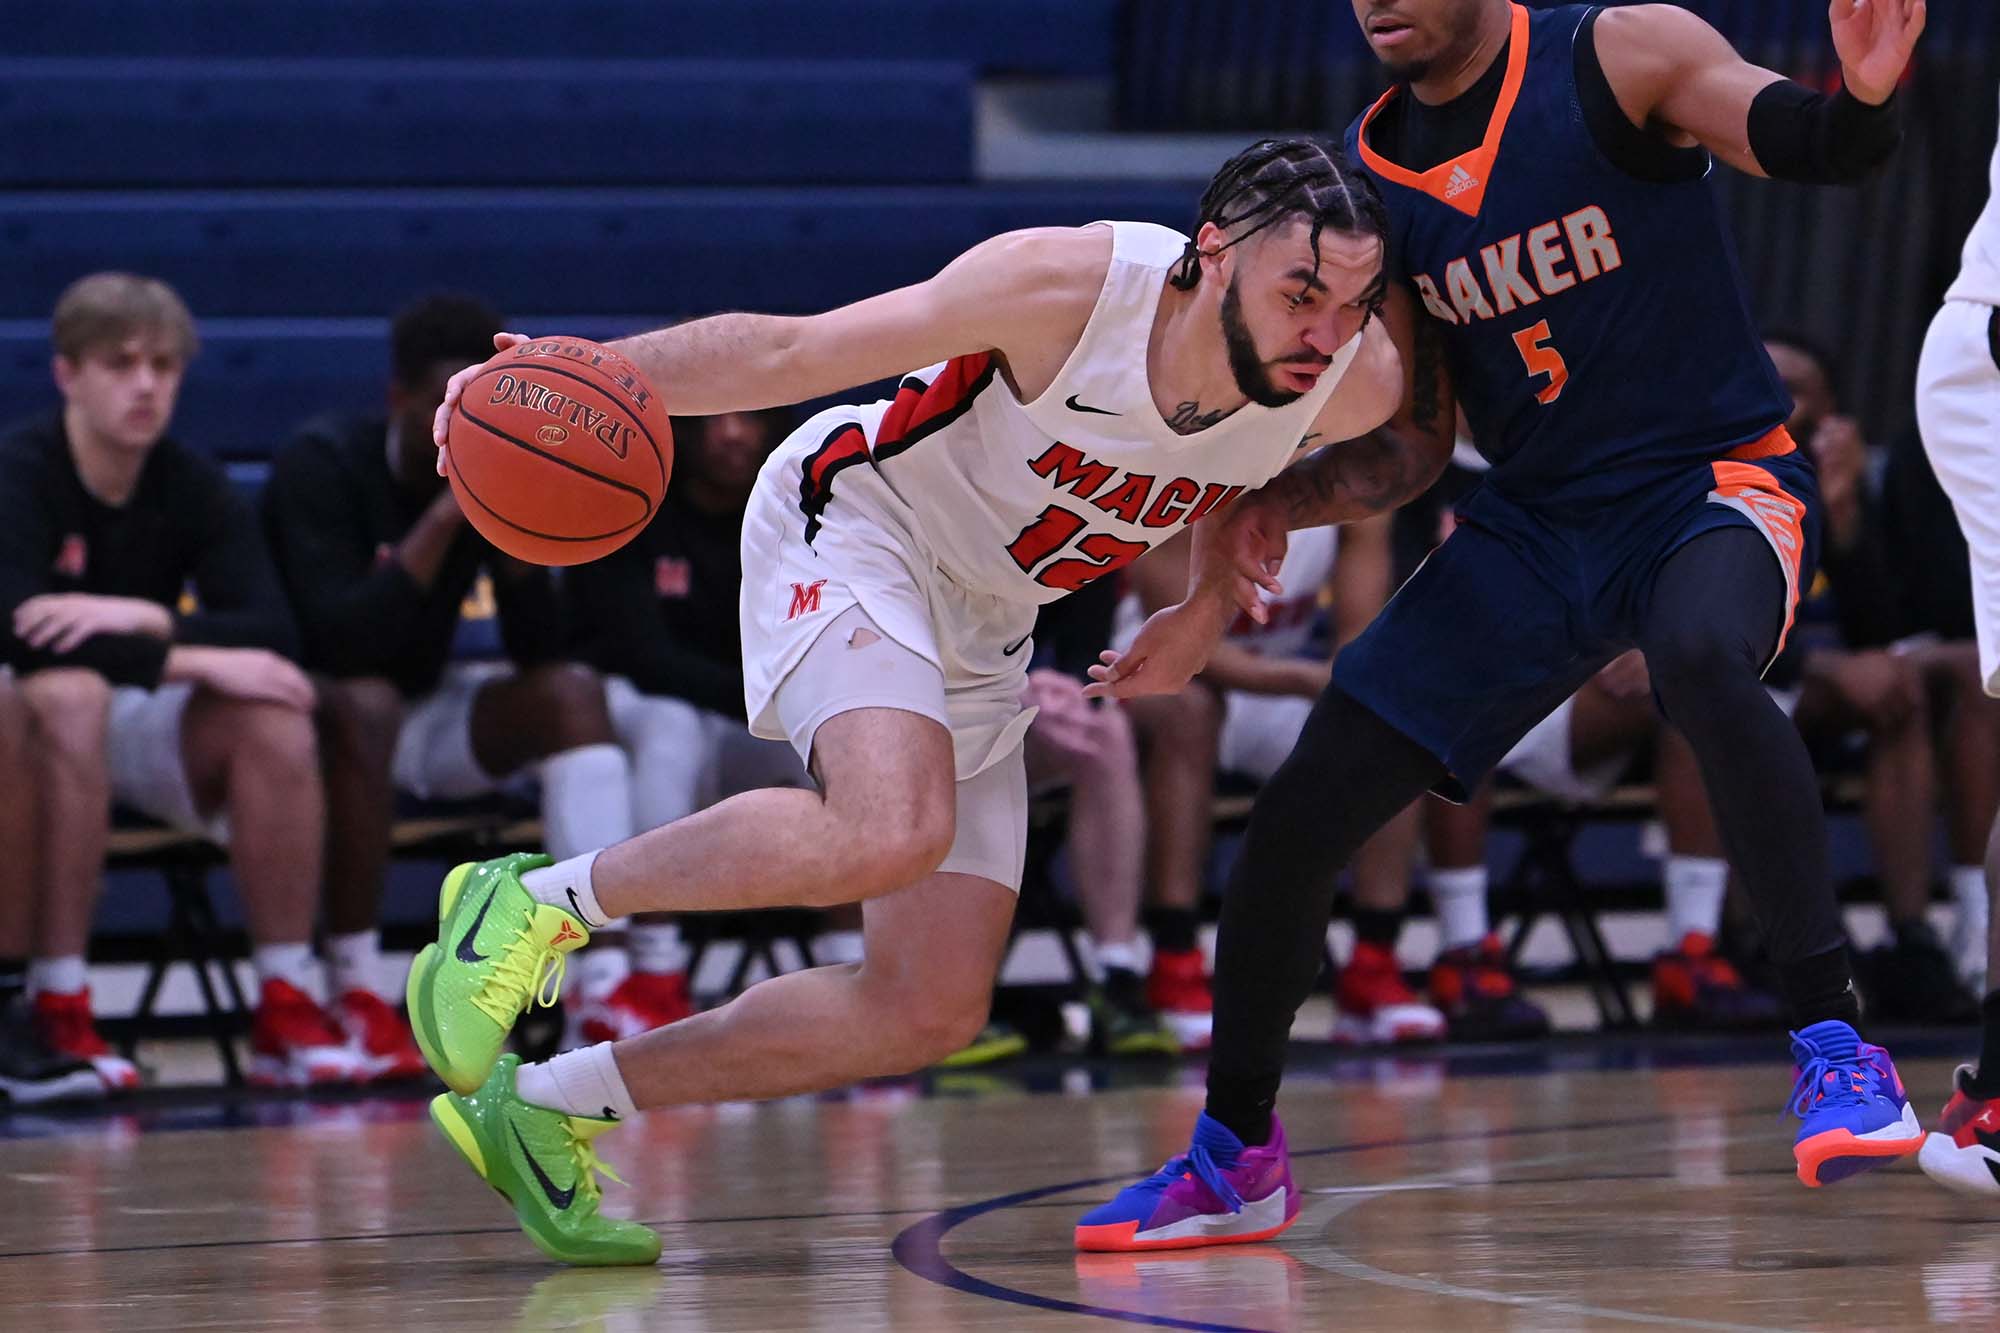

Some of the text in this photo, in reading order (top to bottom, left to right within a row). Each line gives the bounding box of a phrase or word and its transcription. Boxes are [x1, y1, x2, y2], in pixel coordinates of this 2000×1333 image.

[1444, 178, 1480, 199] adidas
[1411, 204, 1623, 326] BAKER
[1511, 318, 1569, 405] 5
[489, 374, 637, 460] SPALDING
[1026, 440, 1246, 528] MACU
[1004, 503, 1151, 592] 12
[782, 578, 828, 624] M
